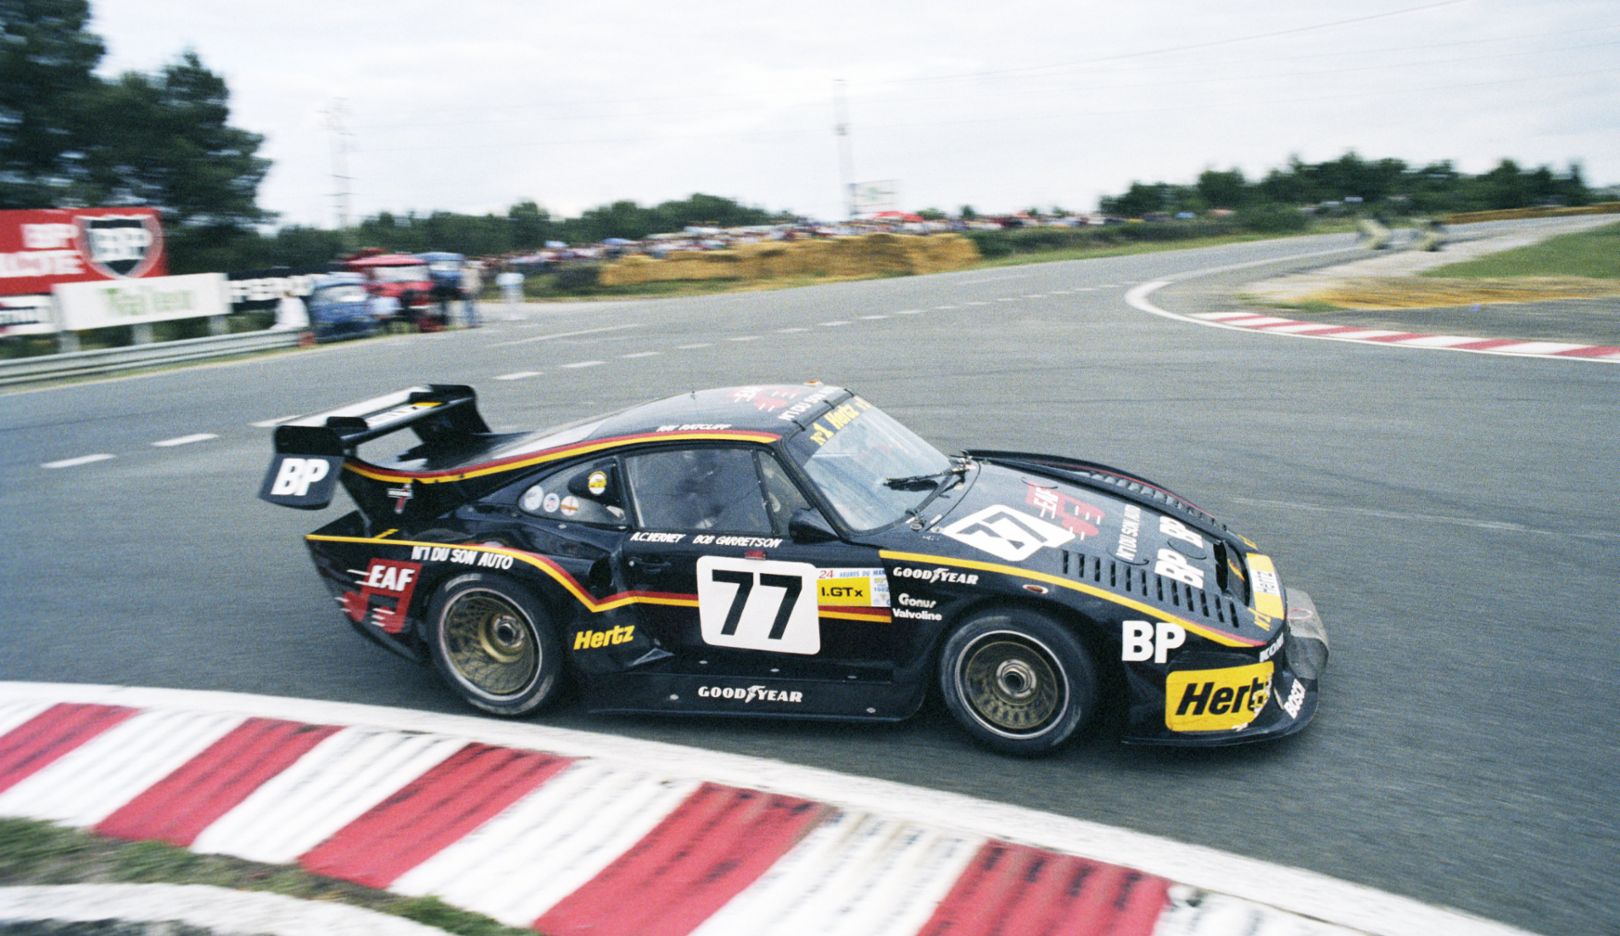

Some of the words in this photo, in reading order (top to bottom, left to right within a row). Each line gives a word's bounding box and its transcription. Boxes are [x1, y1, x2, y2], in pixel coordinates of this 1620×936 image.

[85, 228, 153, 261] BP
[270, 458, 330, 496] BP
[692, 534, 716, 545] BOB
[715, 536, 783, 549] GARRETSON
[1159, 515, 1204, 549] BP
[430, 547, 450, 562] DU
[450, 549, 478, 565] SON
[477, 552, 514, 570] AUTO
[1154, 548, 1205, 589] BP
[368, 565, 416, 592] EAF
[819, 569, 834, 579] 24
[893, 566, 979, 585] GOODYEAR
[711, 569, 803, 640] 77
[892, 607, 943, 622] Valvoline
[573, 624, 635, 650] Hertz
[1121, 619, 1187, 664] BP
[698, 685, 803, 703] GOODYEAR
